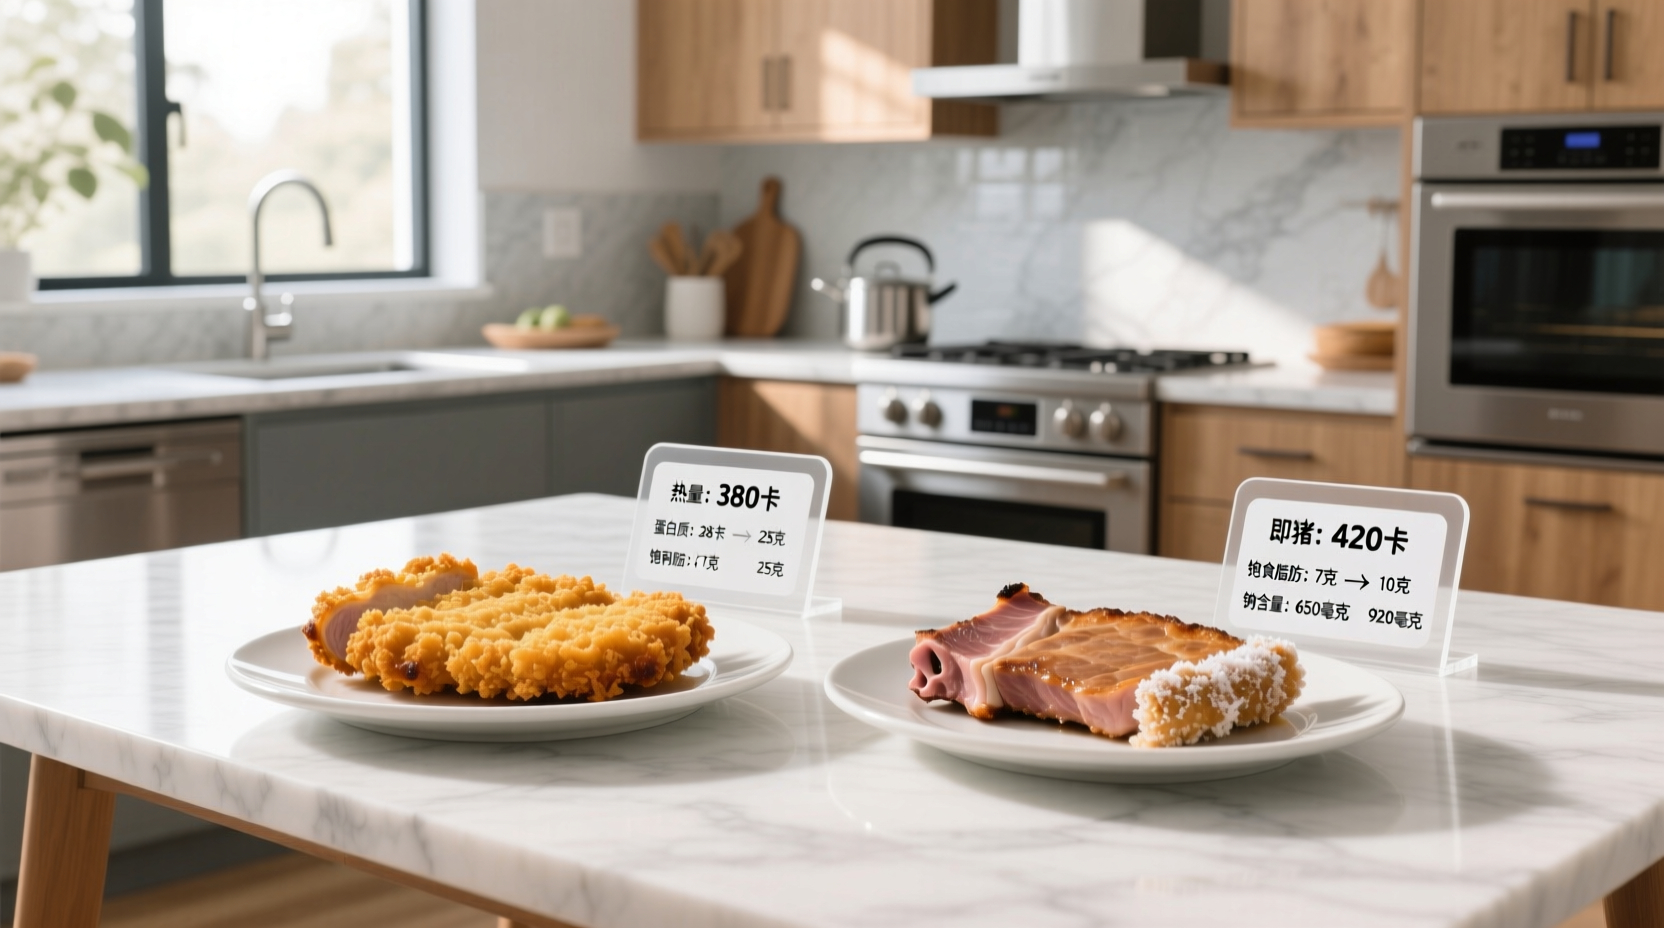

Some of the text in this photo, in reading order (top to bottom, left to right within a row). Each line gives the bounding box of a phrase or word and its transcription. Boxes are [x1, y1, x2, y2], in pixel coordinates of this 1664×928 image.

[716, 483, 780, 512] 380卡
[758, 530, 785, 546] 25克
[1331, 524, 1408, 555] 420卡
[757, 561, 784, 577] 25克
[1316, 568, 1338, 586] 7克
[1380, 576, 1411, 594] 10克
